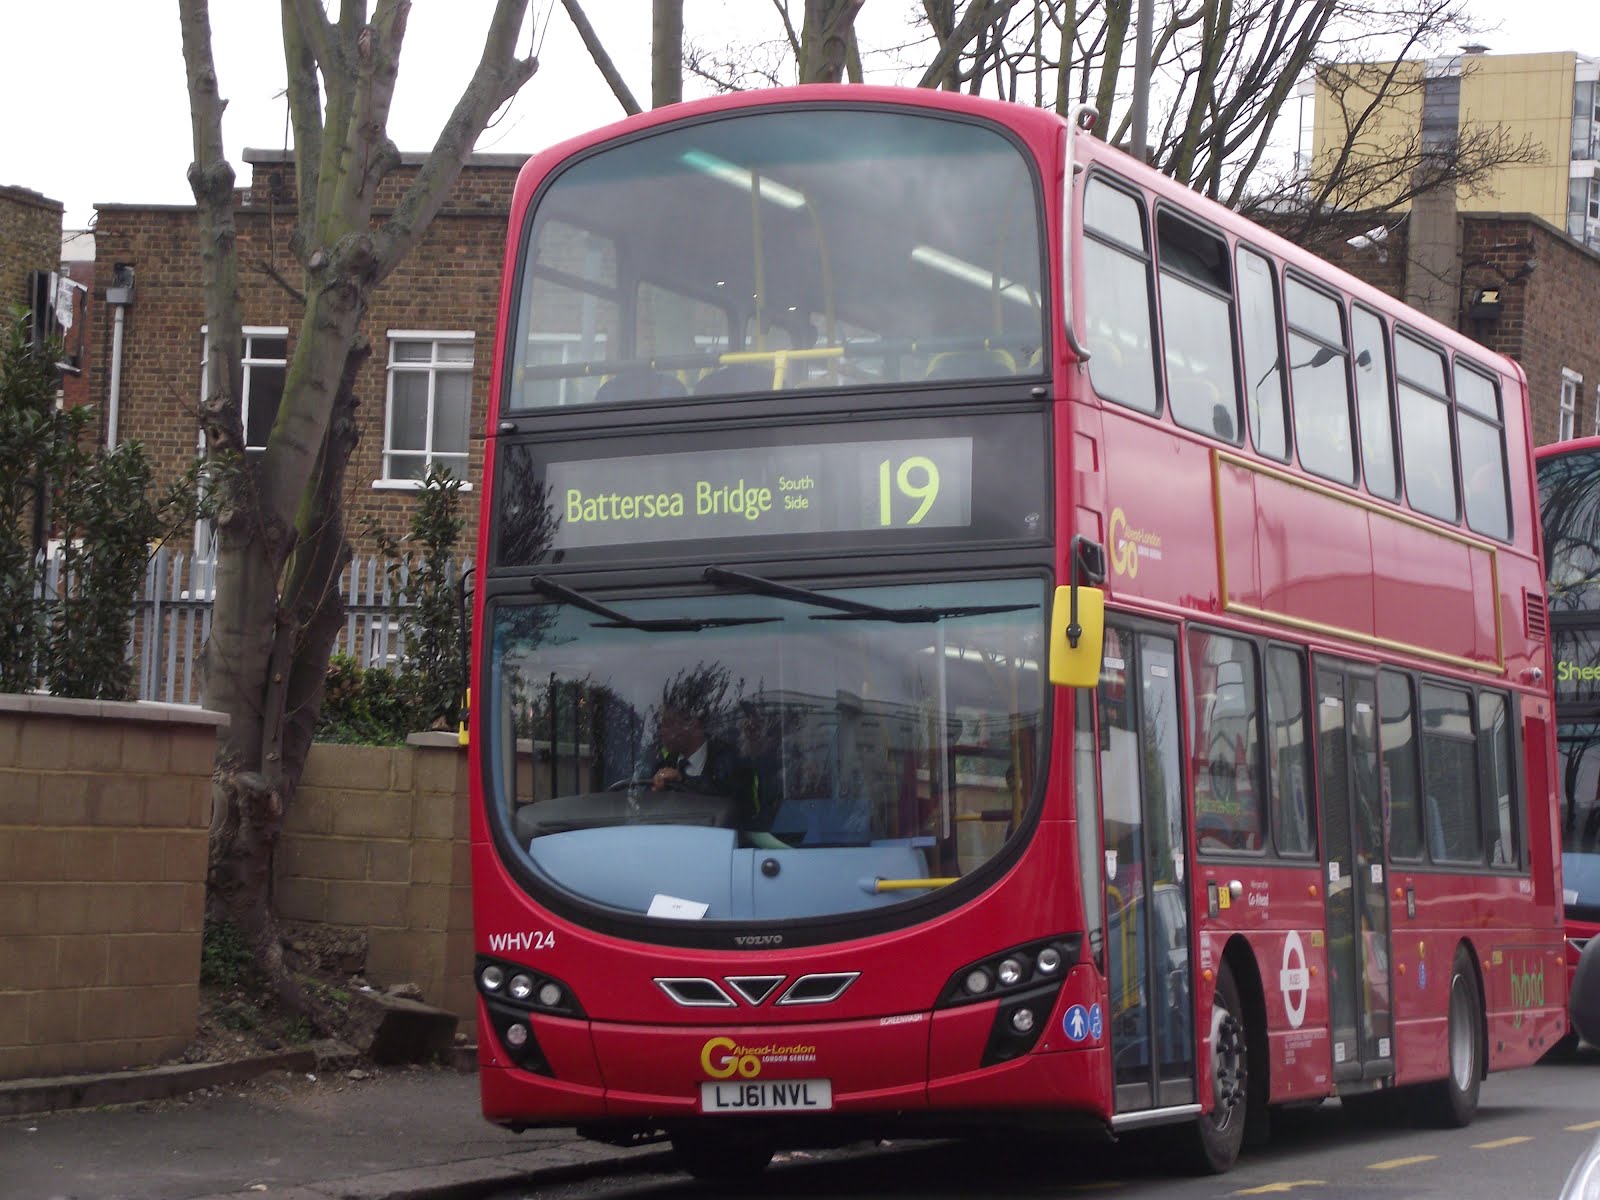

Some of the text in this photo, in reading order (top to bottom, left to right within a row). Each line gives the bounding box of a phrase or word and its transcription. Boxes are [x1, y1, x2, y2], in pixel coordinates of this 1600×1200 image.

[779, 475, 814, 491] South
[880, 456, 940, 526] 19
[567, 479, 772, 522] Battersea Bridge
[784, 495, 809, 509] Side
[489, 930, 555, 951] WHV24
[734, 935, 783, 945] VOLVO
[701, 1036, 762, 1079] Go
[733, 1043, 816, 1056] Ahead-London
[762, 1053, 817, 1063] LONDON GENERAL
[715, 1083, 817, 1107] LJ61 NVL
